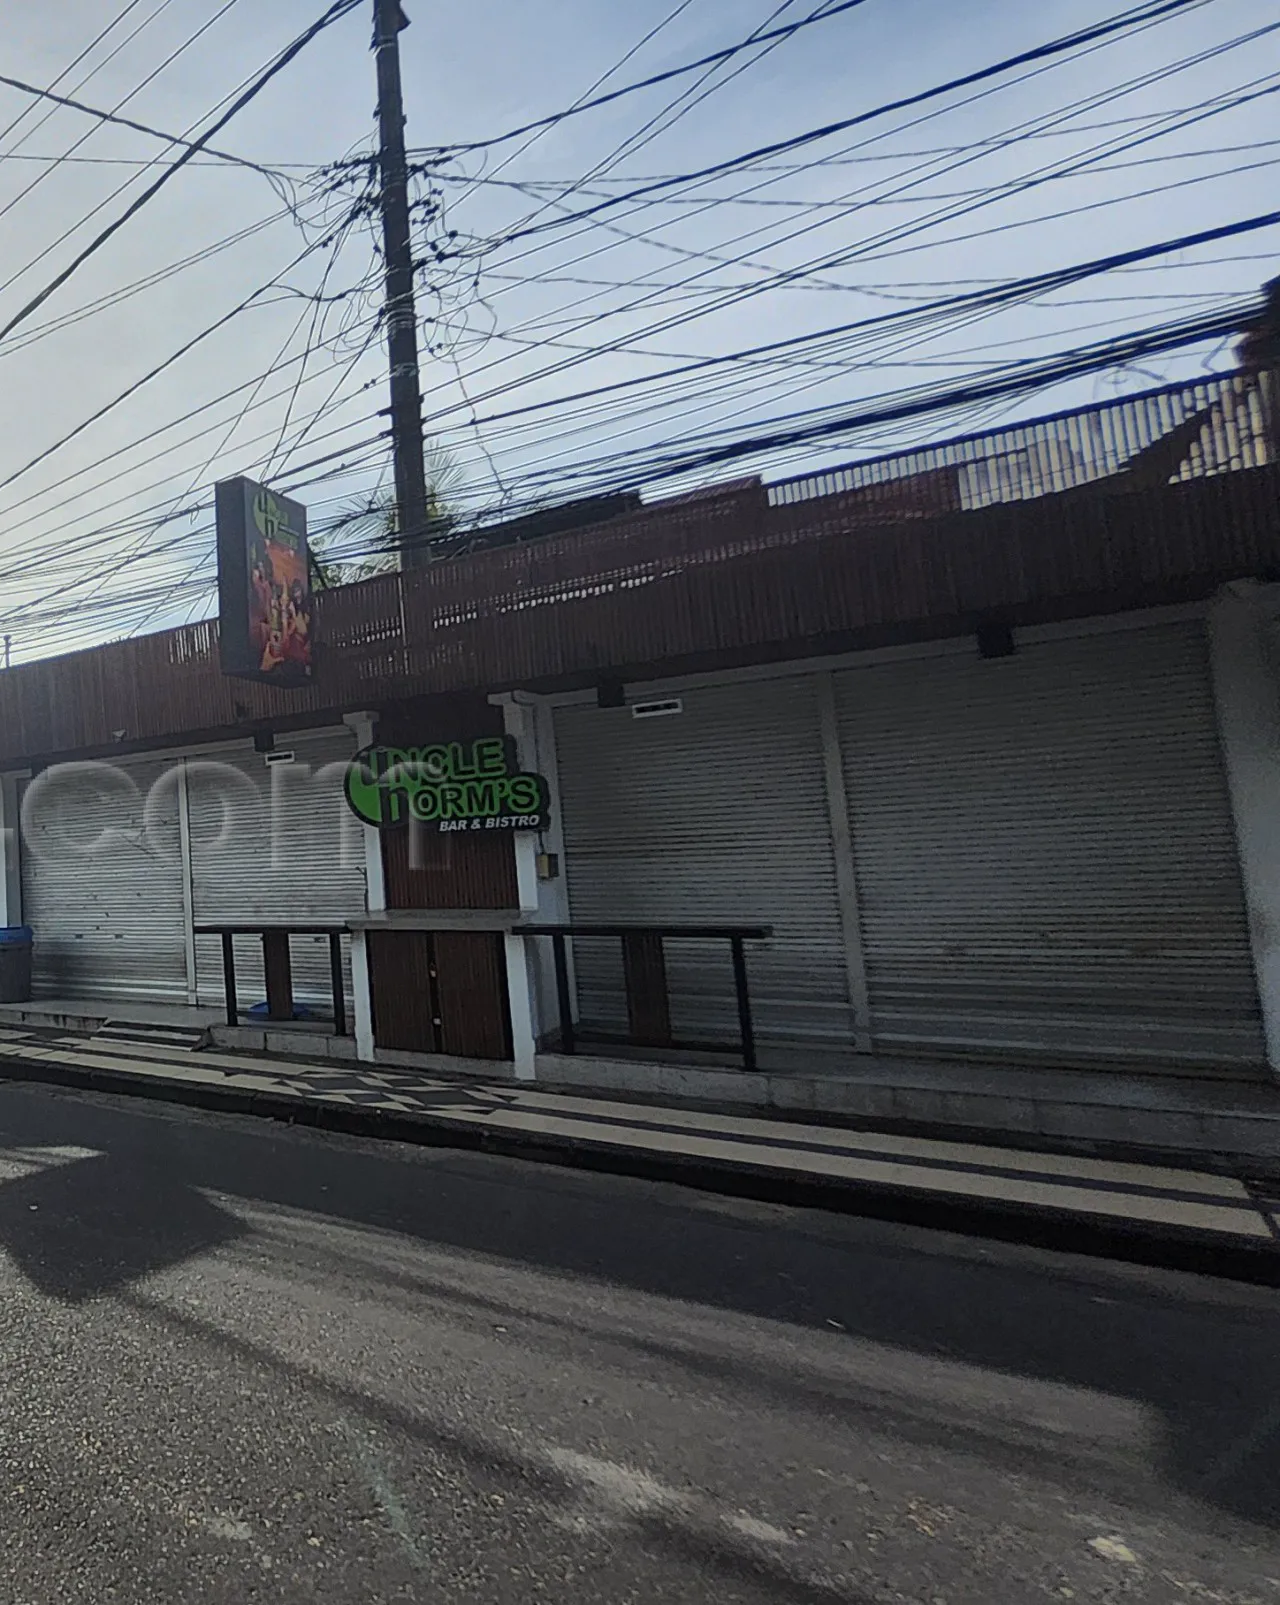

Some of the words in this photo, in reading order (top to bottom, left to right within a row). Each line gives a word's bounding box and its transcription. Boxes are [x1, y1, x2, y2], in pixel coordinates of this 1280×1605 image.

[440, 819, 467, 831] BAR
[470, 820, 480, 829] &
[485, 815, 540, 828] BISTRO
